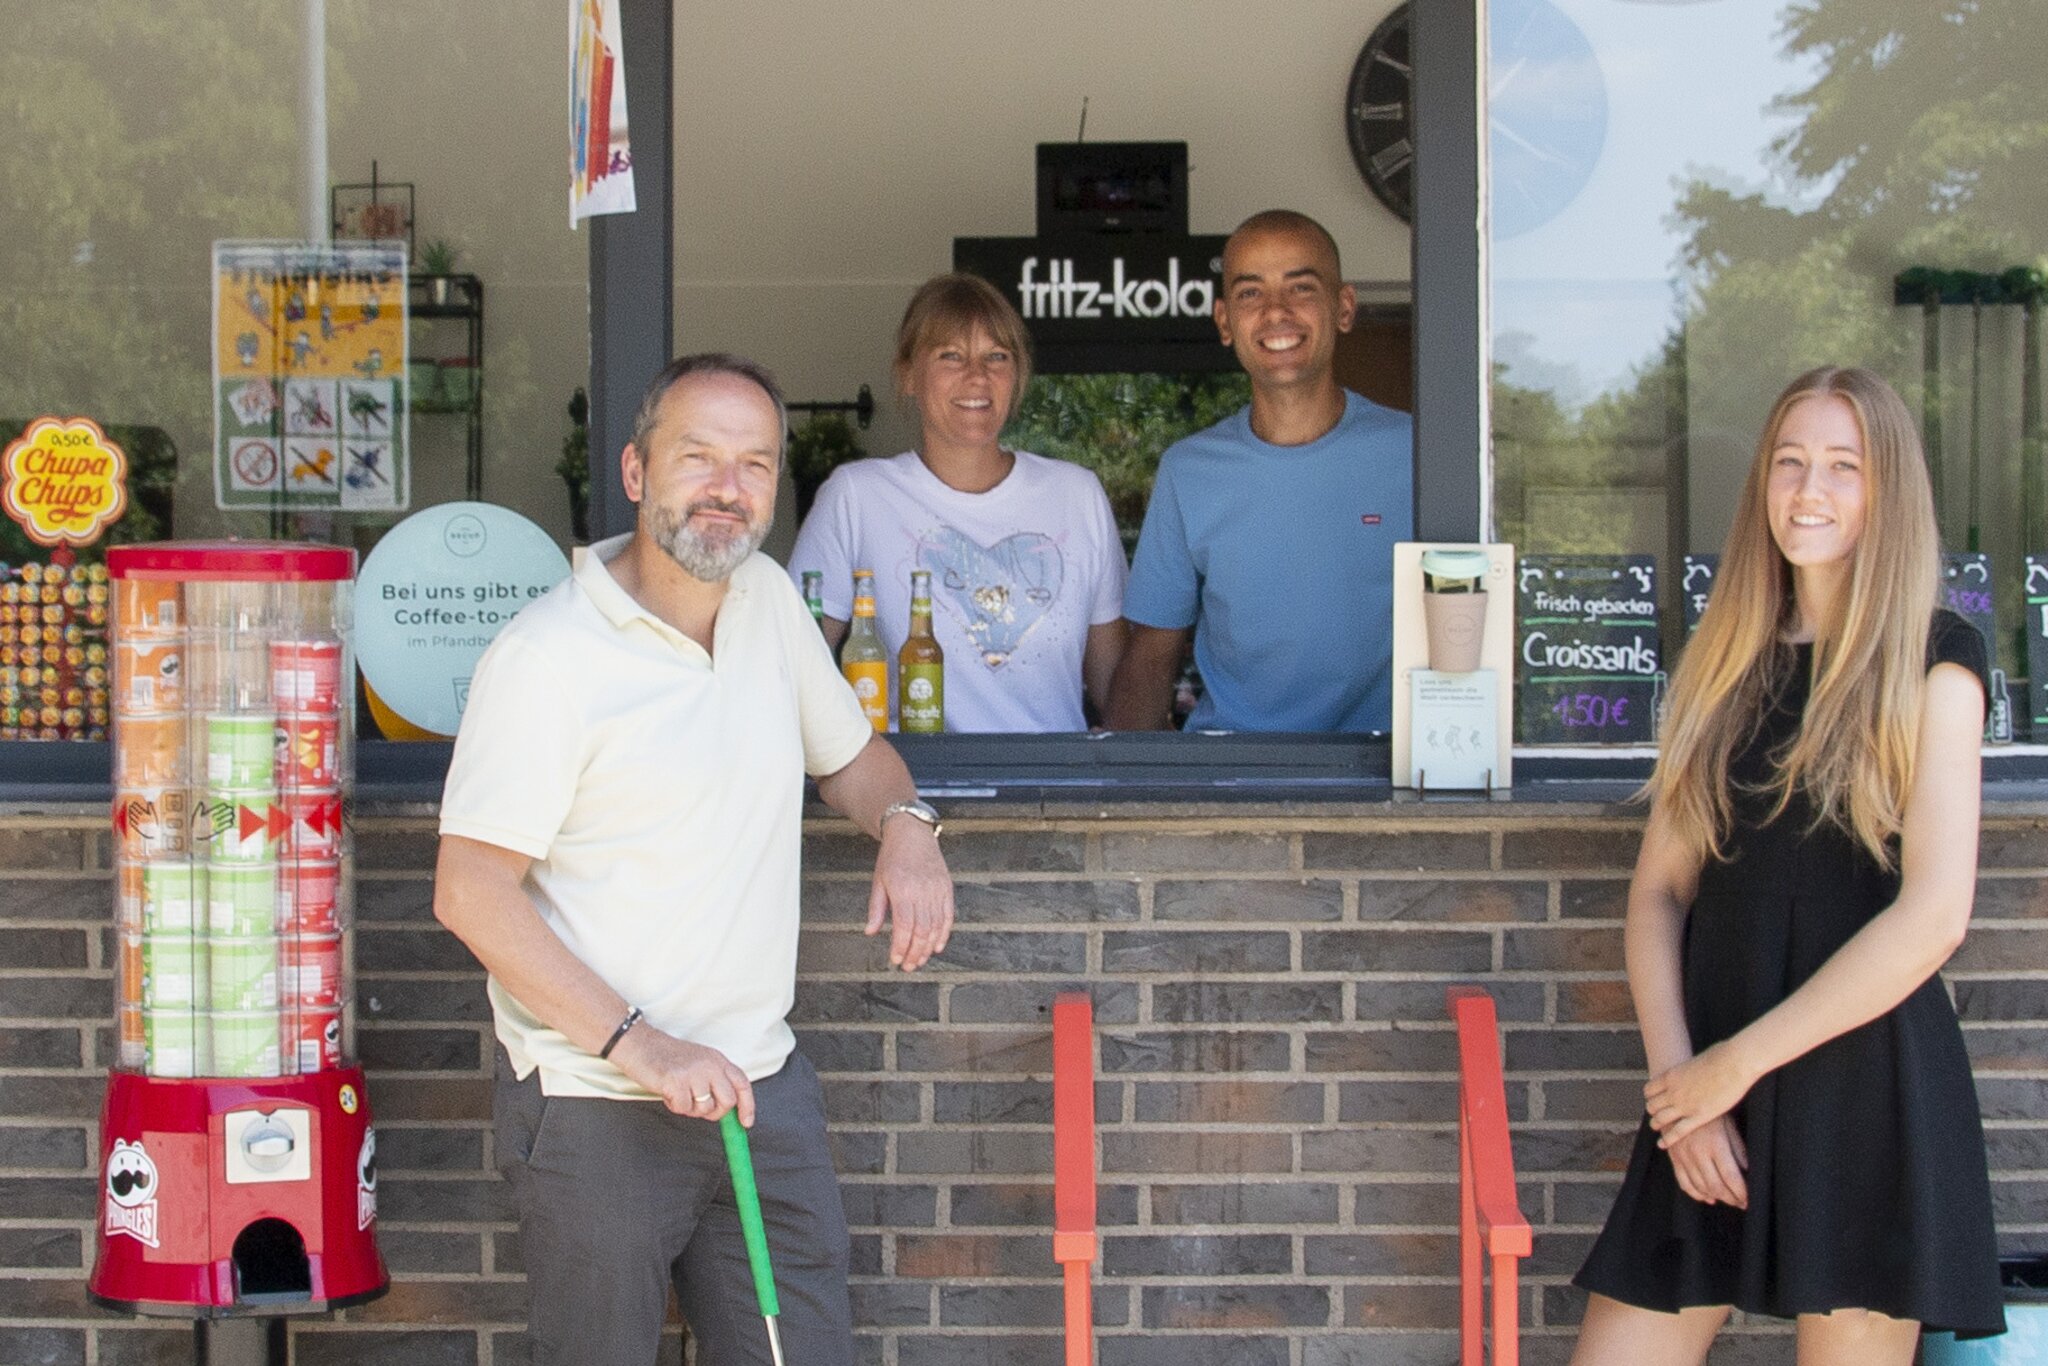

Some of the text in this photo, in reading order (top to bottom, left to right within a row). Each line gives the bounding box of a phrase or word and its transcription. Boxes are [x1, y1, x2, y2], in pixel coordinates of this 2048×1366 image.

[1018, 257, 1214, 317] fritz-kola
[24, 447, 108, 482] Chupa
[19, 477, 104, 523] Chups
[382, 582, 550, 603] Bei uns gibt es
[394, 608, 519, 625] Coffee-to-
[1583, 598, 1655, 622] gebacken
[407, 635, 427, 648] im
[1523, 632, 1657, 674] Croissants
